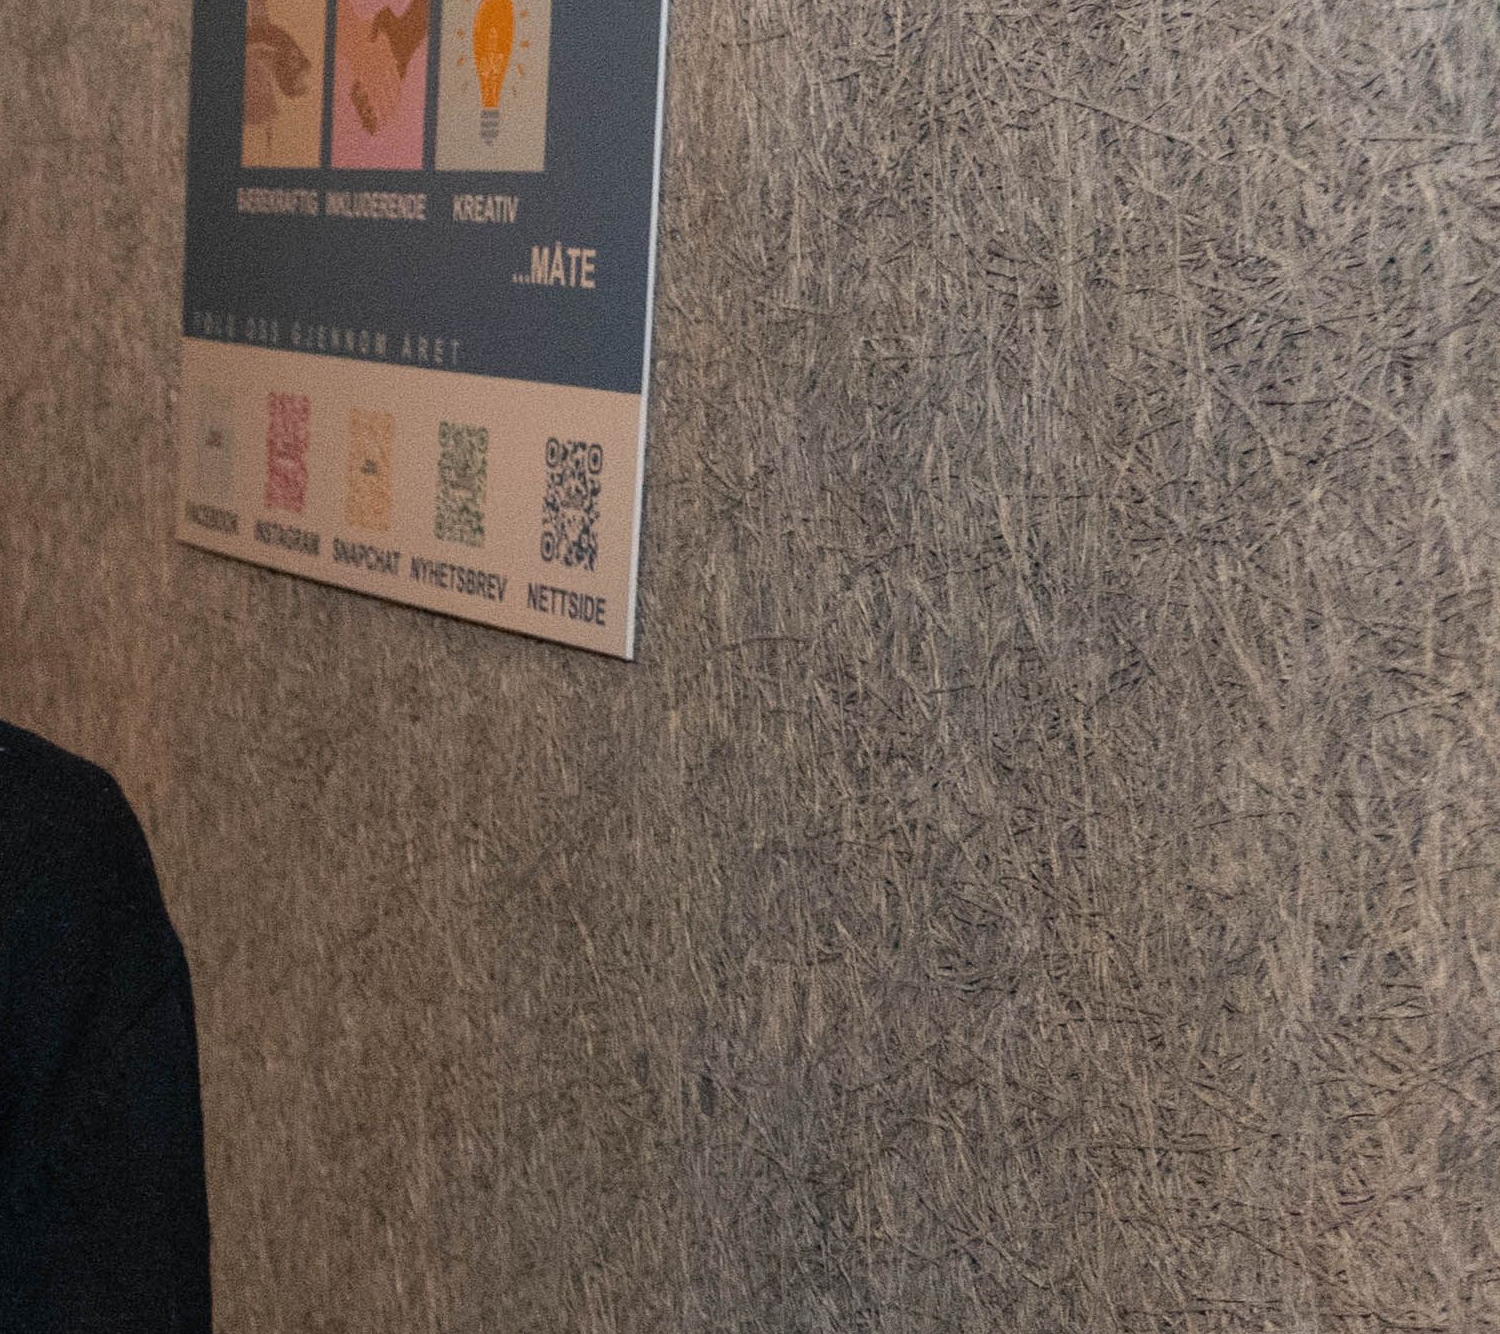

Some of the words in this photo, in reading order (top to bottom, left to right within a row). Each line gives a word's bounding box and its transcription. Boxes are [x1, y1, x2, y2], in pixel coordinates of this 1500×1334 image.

[453, 193, 519, 224] KREATIV
[332, 537, 399, 577] SNAPCHAT
[410, 556, 508, 604] NYHETSBREV
[527, 582, 606, 627] NETTSIDE
